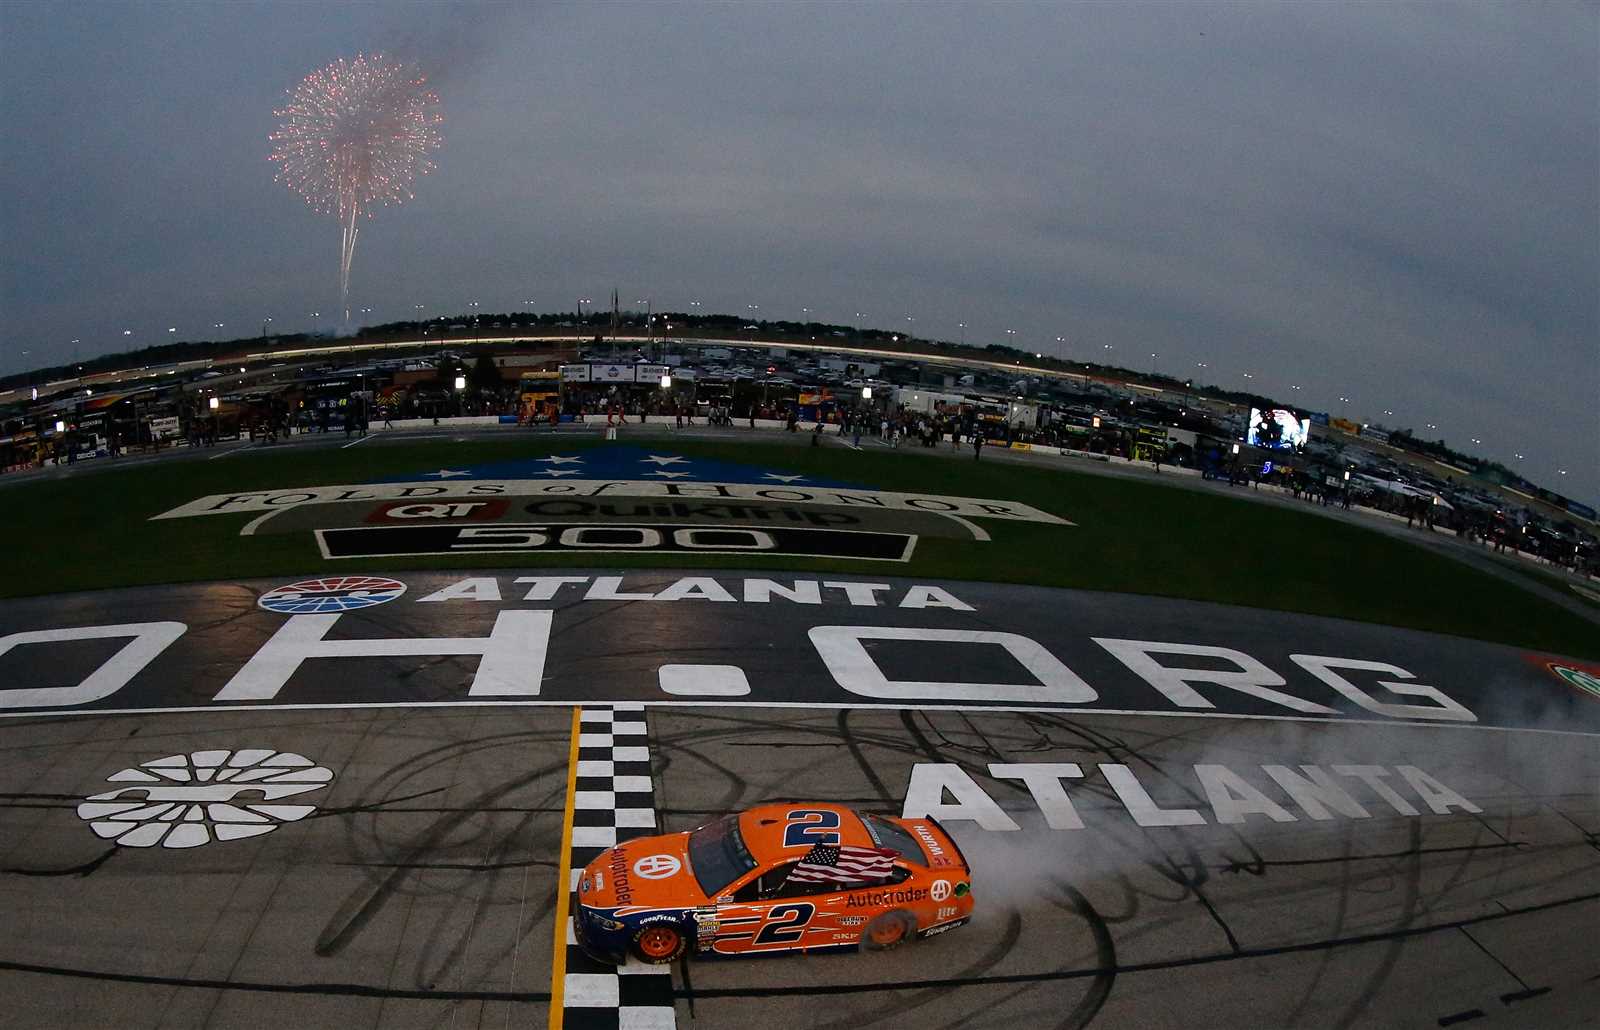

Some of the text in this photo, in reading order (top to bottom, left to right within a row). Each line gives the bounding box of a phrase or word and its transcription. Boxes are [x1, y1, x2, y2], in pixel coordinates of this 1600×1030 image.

[208, 481, 1024, 518] FOLDS of HONOR
[524, 500, 861, 527] QuikTrip
[450, 527, 777, 551] 500
[416, 576, 978, 612] ATLANTA
[902, 762, 1483, 831] ATLANTA
[783, 809, 840, 848] 2
[611, 847, 635, 906] Autotrader
[846, 887, 928, 909] Autotrader
[752, 902, 816, 945] 2
